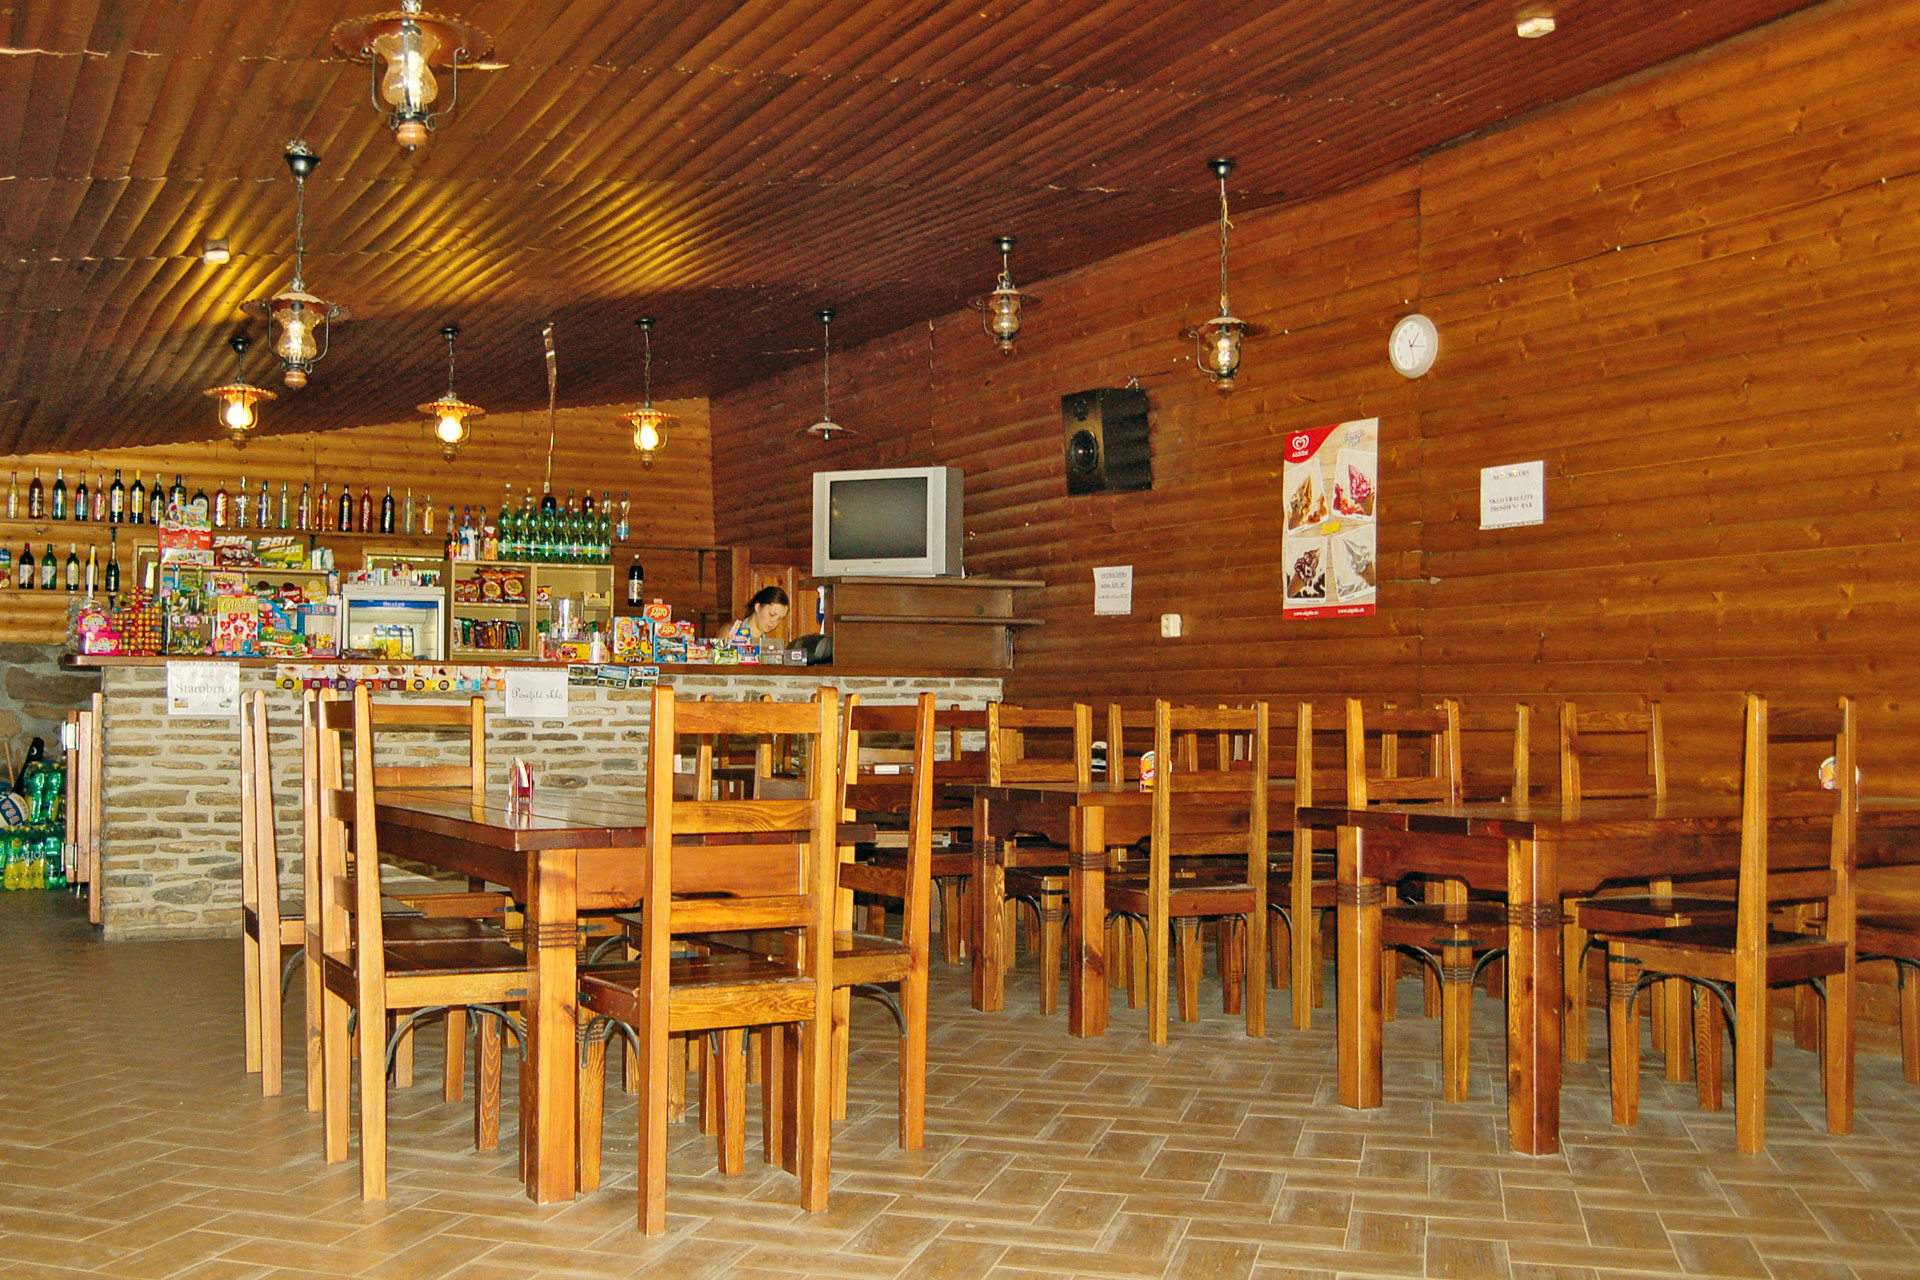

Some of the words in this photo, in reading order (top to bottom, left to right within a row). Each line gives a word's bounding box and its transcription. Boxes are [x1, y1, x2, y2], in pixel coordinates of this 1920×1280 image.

[212, 535, 248, 548] 3BIT
[257, 536, 295, 550] 3BIT
[176, 683, 232, 695] Starobrno
[545, 688, 563, 699] sklo
